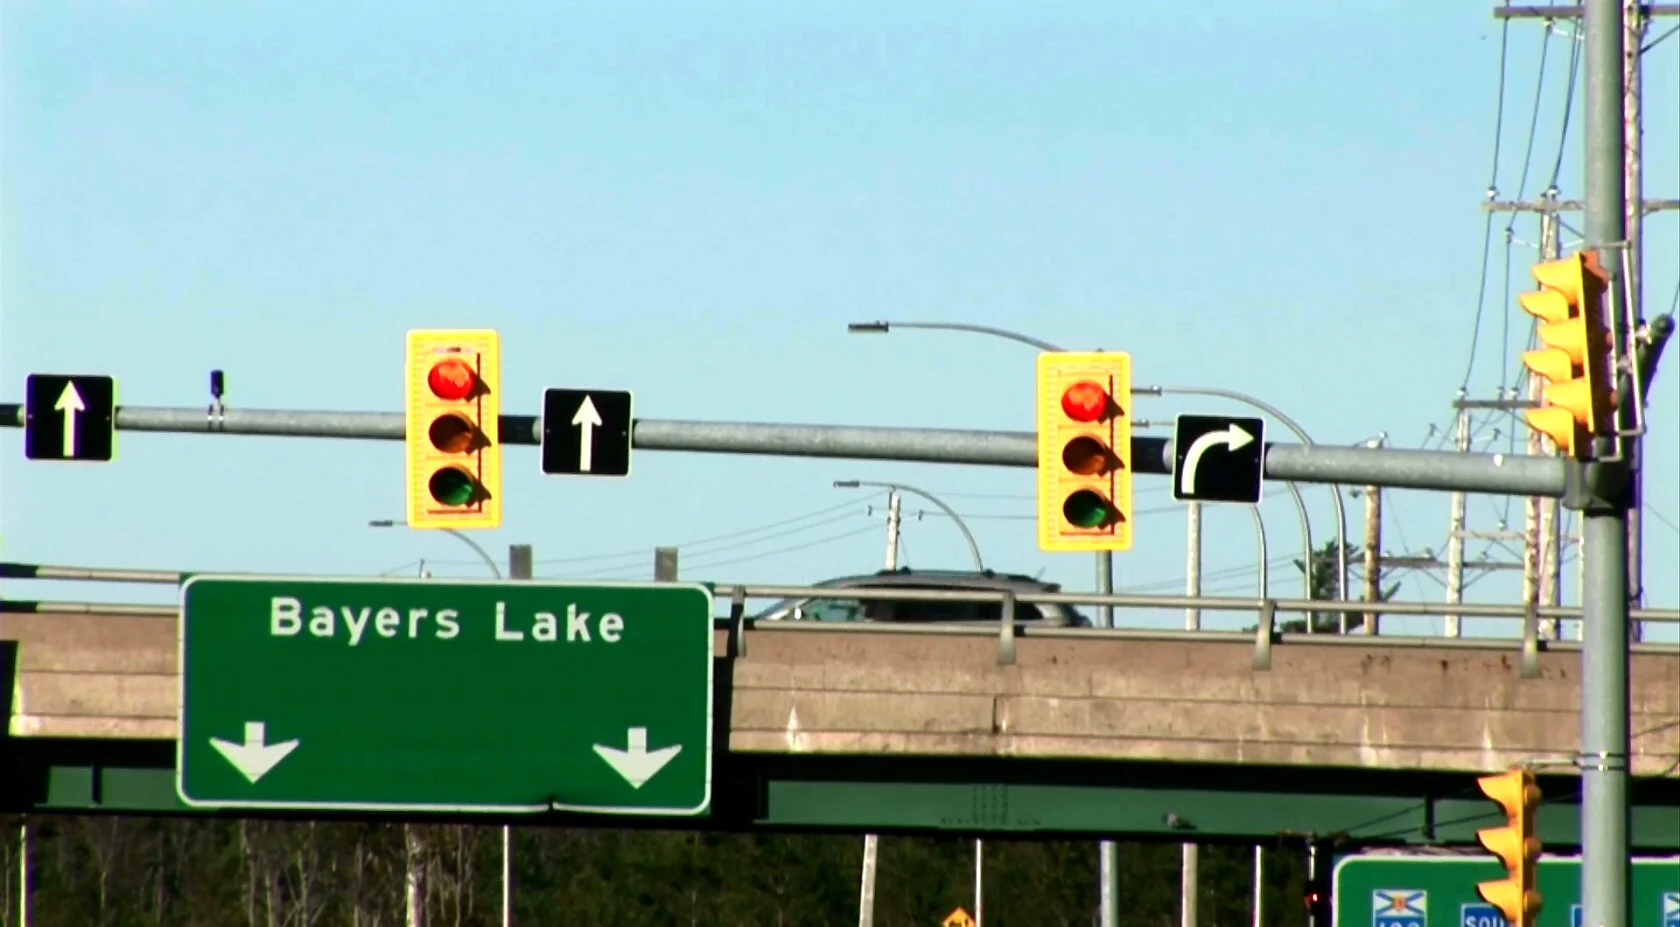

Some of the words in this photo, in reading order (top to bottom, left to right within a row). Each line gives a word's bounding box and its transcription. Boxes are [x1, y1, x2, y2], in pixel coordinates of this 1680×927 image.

[271, 596, 460, 646] Bayers
[495, 601, 624, 642] Lake
[1466, 916, 1505, 927] SOU
